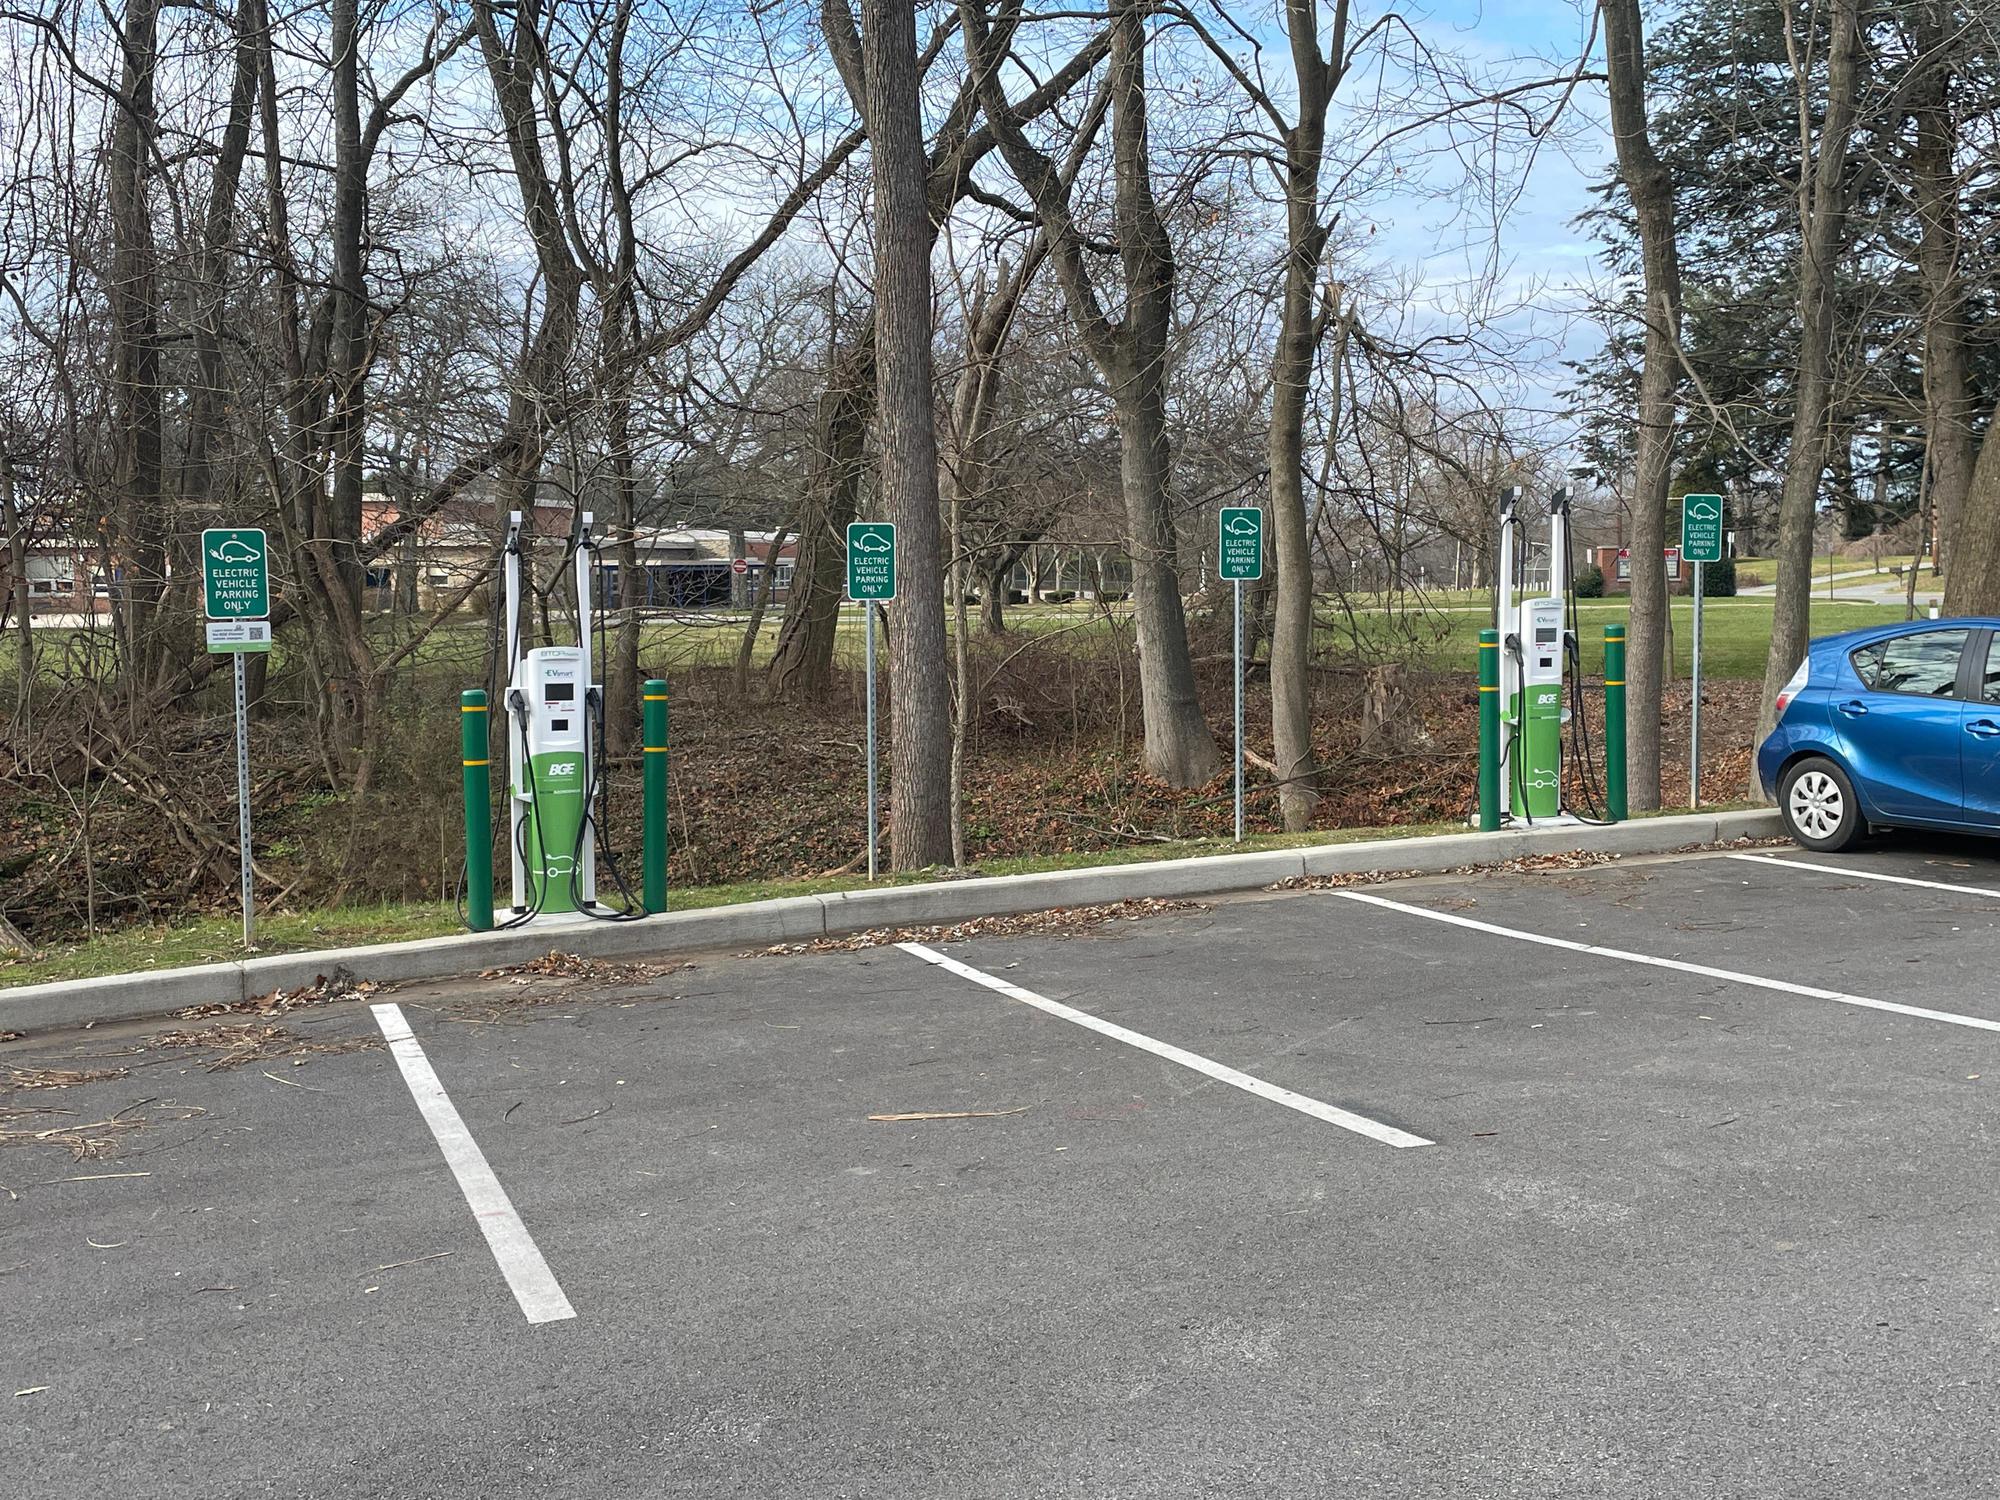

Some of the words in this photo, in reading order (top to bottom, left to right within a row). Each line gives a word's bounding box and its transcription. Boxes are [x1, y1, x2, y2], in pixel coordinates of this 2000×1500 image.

[1688, 523, 1717, 531] ELECTRIC
[1690, 531, 1715, 539] VEHICLE
[1225, 539, 1257, 547] ELECTRIC
[854, 557, 889, 565] ELECTRIC
[1226, 556, 1256, 564] PARKING
[212, 568, 259, 578] ELECTRIC
[856, 566, 888, 574] VEHICLE
[1231, 565, 1250, 573] ONLY
[855, 575, 889, 583] PARKING
[215, 579, 258, 588] VEHICLE
[861, 584, 883, 593] ONLY
[215, 589, 259, 599] PARKING
[223, 600, 251, 610] ONLY
[1537, 694, 1557, 704] BGE
[549, 763, 575, 775] BGE
